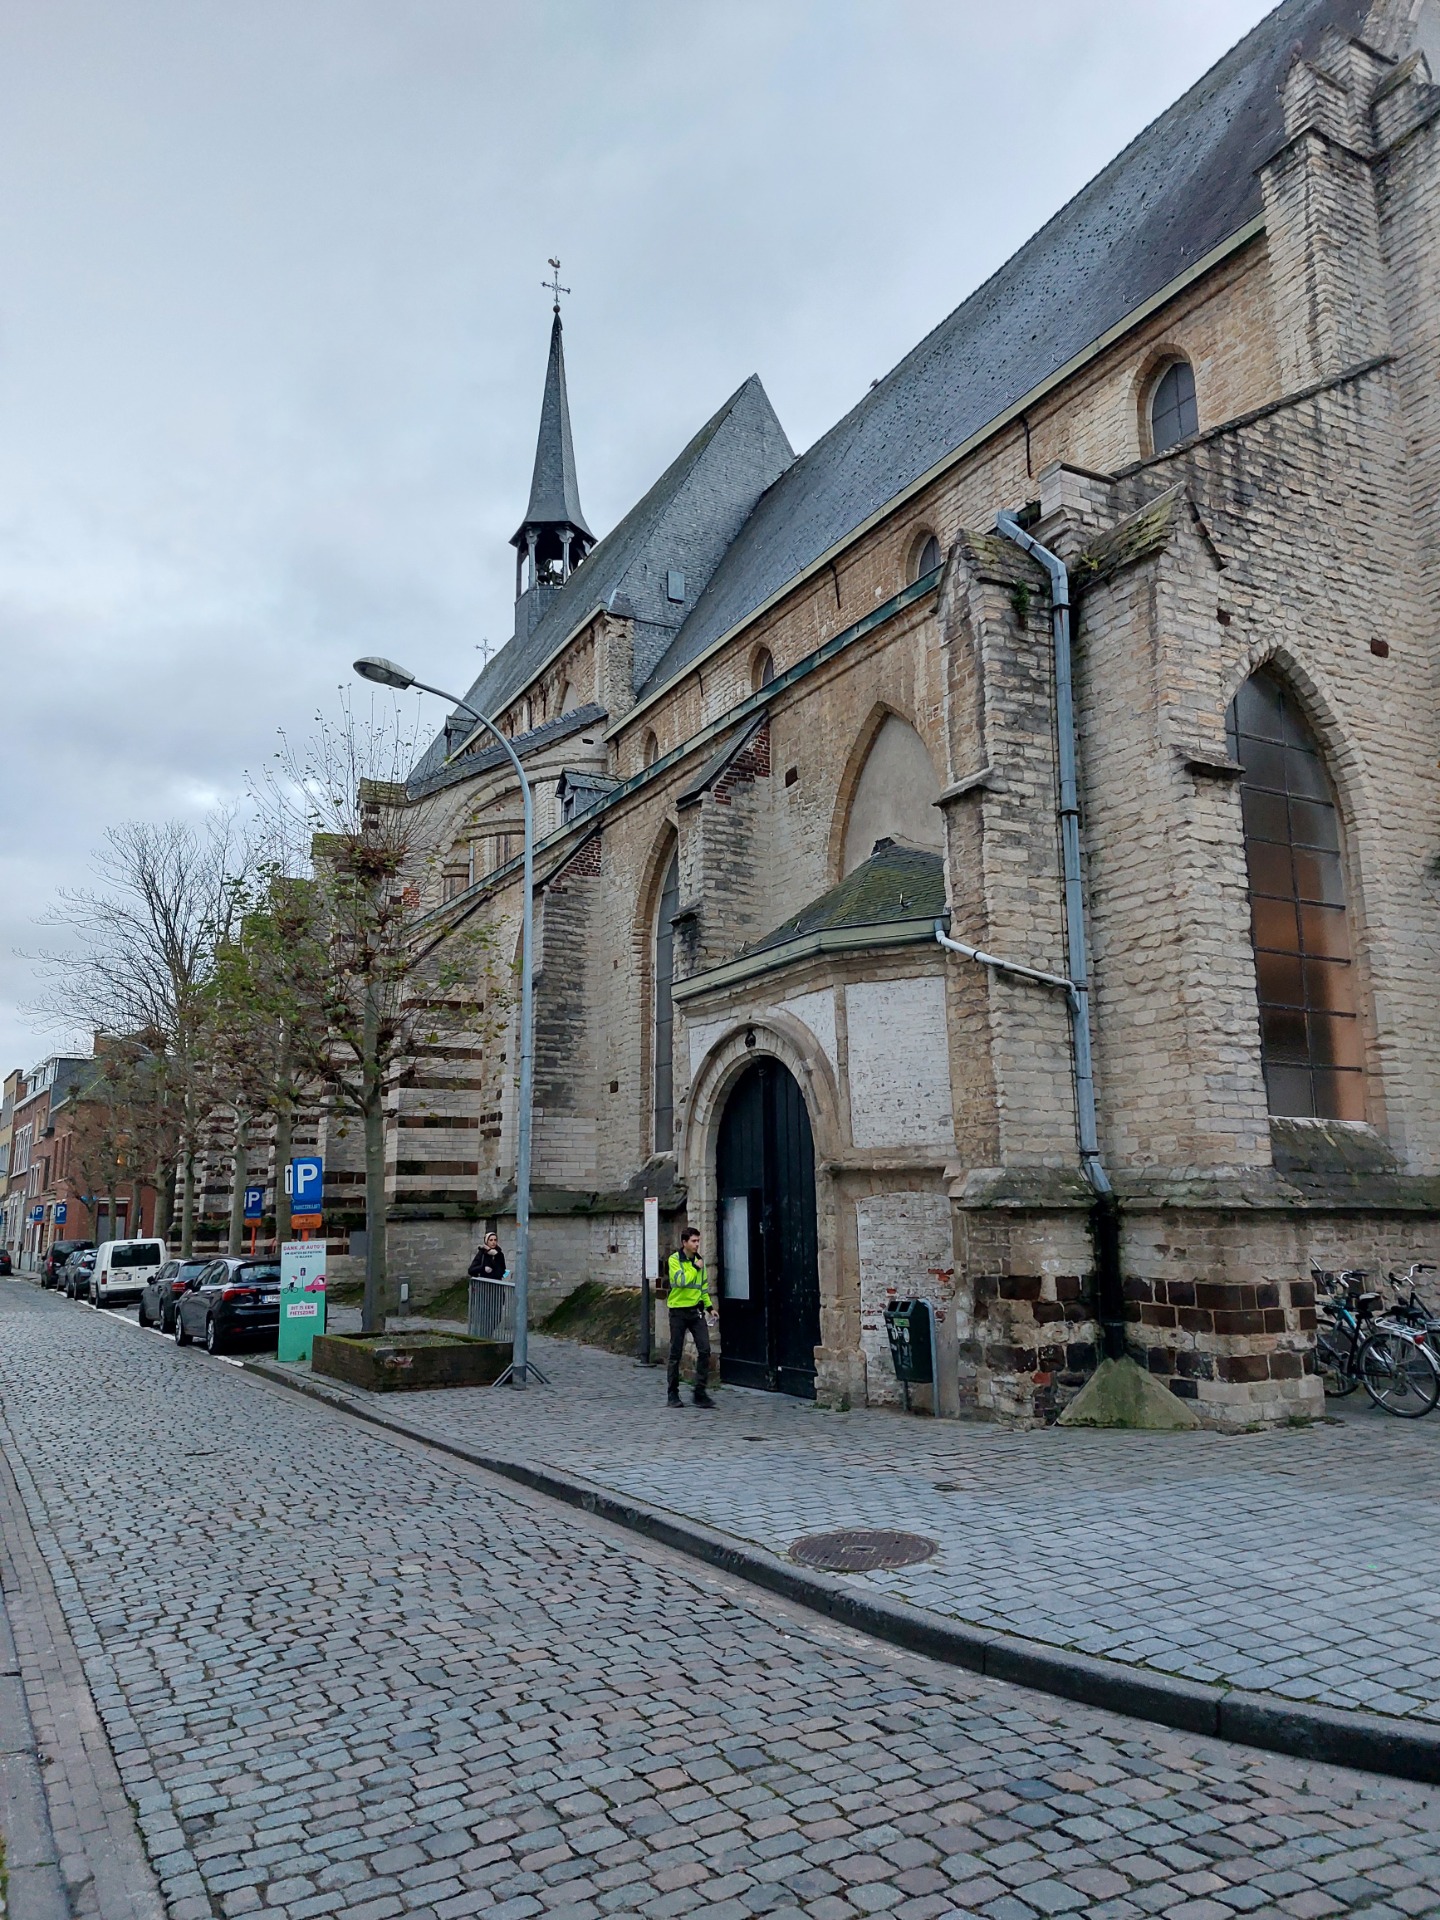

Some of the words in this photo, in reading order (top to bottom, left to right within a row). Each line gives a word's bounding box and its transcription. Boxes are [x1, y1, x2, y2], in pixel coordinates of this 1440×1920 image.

[298, 1164, 318, 1194] P
[248, 1191, 260, 1207] P
[36, 1206, 42, 1215] P
[57, 1206, 65, 1217] P
